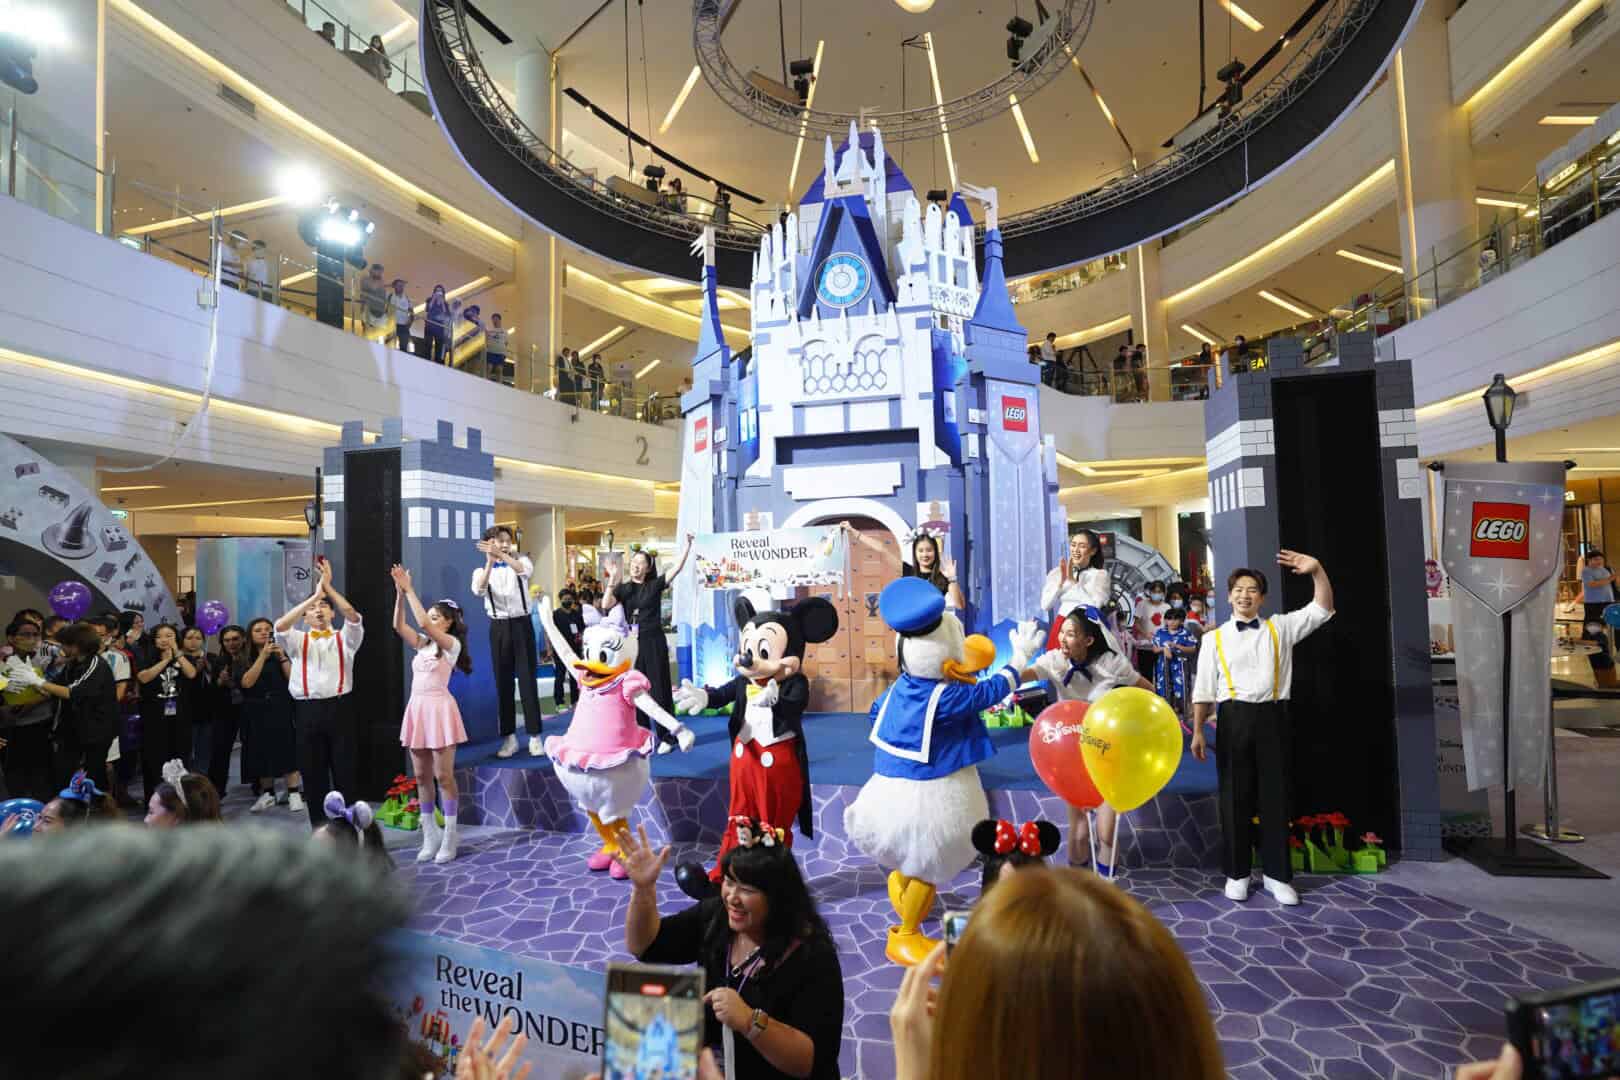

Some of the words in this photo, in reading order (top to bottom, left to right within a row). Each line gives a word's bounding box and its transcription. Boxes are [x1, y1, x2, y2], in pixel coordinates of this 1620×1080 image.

[635, 434, 650, 466] 2
[730, 536, 770, 549] Reveal
[1475, 518, 1527, 542] LEGO
[733, 551, 749, 560] the
[748, 547, 808, 561] WONDER
[437, 955, 523, 1001] Reveal
[441, 989, 472, 1016] the
